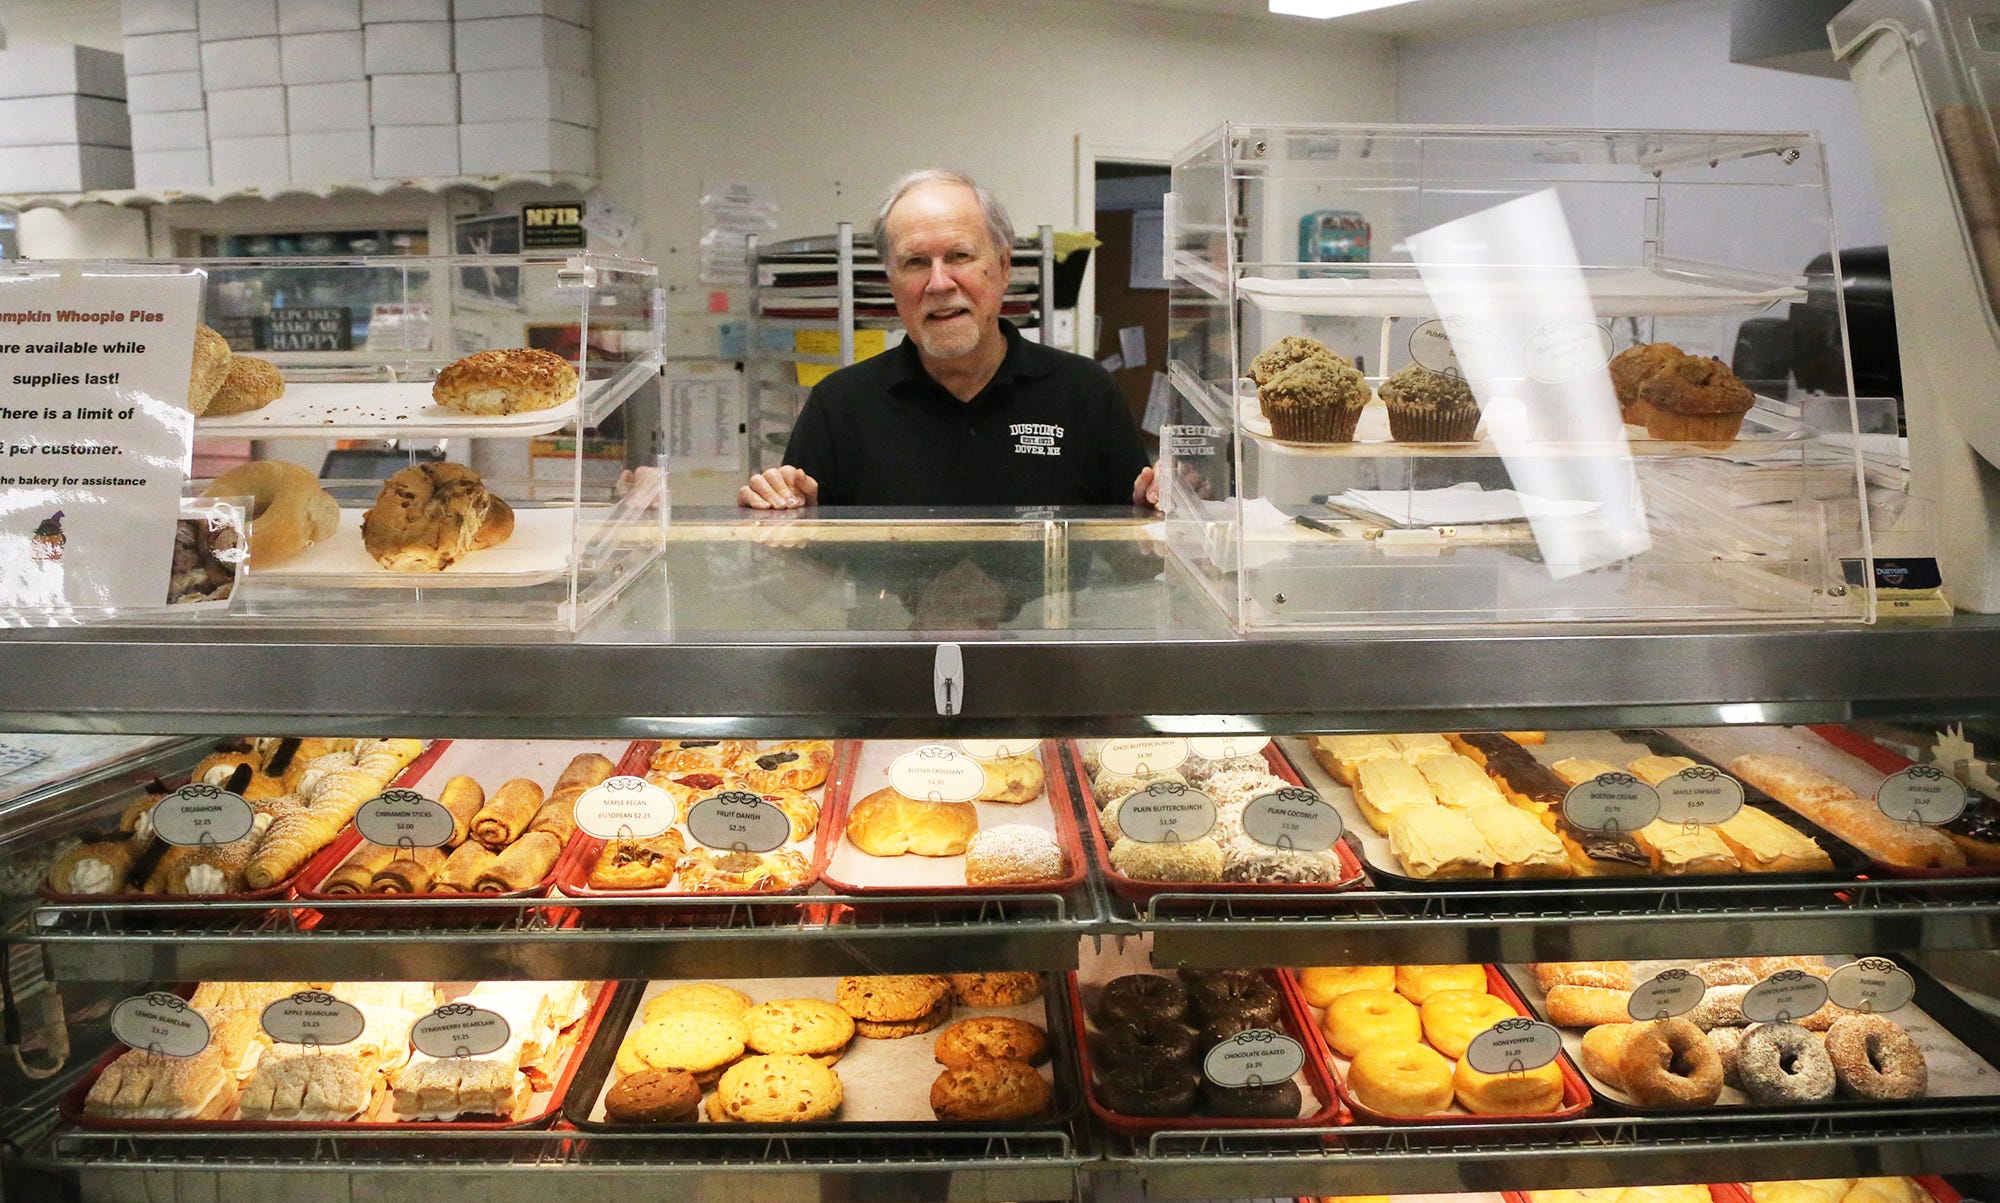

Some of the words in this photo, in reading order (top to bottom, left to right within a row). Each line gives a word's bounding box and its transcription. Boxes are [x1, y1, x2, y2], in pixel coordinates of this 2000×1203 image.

[526, 207, 580, 226] NFIB
[0, 310, 51, 325] mpkin
[56, 310, 125, 325] Whoopie
[129, 310, 164, 322] Pies
[271, 309, 340, 320] CUPCAKES
[271, 322, 312, 333] MAKE
[273, 333, 339, 350] HAPPY
[25, 342, 97, 354] available
[103, 342, 146, 354] while
[12, 373, 80, 387] supplies
[85, 373, 119, 385] last!
[43, 408, 57, 419] is
[62, 410, 72, 419] a
[77, 407, 113, 420] limit
[118, 407, 134, 420] of
[1009, 423, 1064, 438] DUSTON'S
[9, 443, 37, 457] per
[41, 442, 122, 456] customer.
[1014, 444, 1046, 455] DOVER,
[1047, 447, 1061, 456] NH
[0, 476, 15, 485] he
[18, 476, 59, 486] bakery
[62, 476, 79, 486] for
[82, 477, 147, 486] assistance
[181, 805, 222, 813] CREAMHORN
[1153, 803, 1202, 812] BUTTERCRUNCH
[1268, 807, 1286, 815] PLAIN
[1287, 809, 1318, 819] COCONUT
[598, 811, 632, 819] EUROPEAN
[736, 812, 760, 820] DANISH
[135, 1010, 157, 1019] LEMON
[159, 1016, 191, 1029] BEARCLAW
[421, 1024, 460, 1033] STRAWBERRY
[462, 1020, 495, 1029] BEARCLAW
[1493, 1037, 1535, 1046] HONEYDIPPED
[1224, 1051, 1260, 1059] CHOCOLATE
